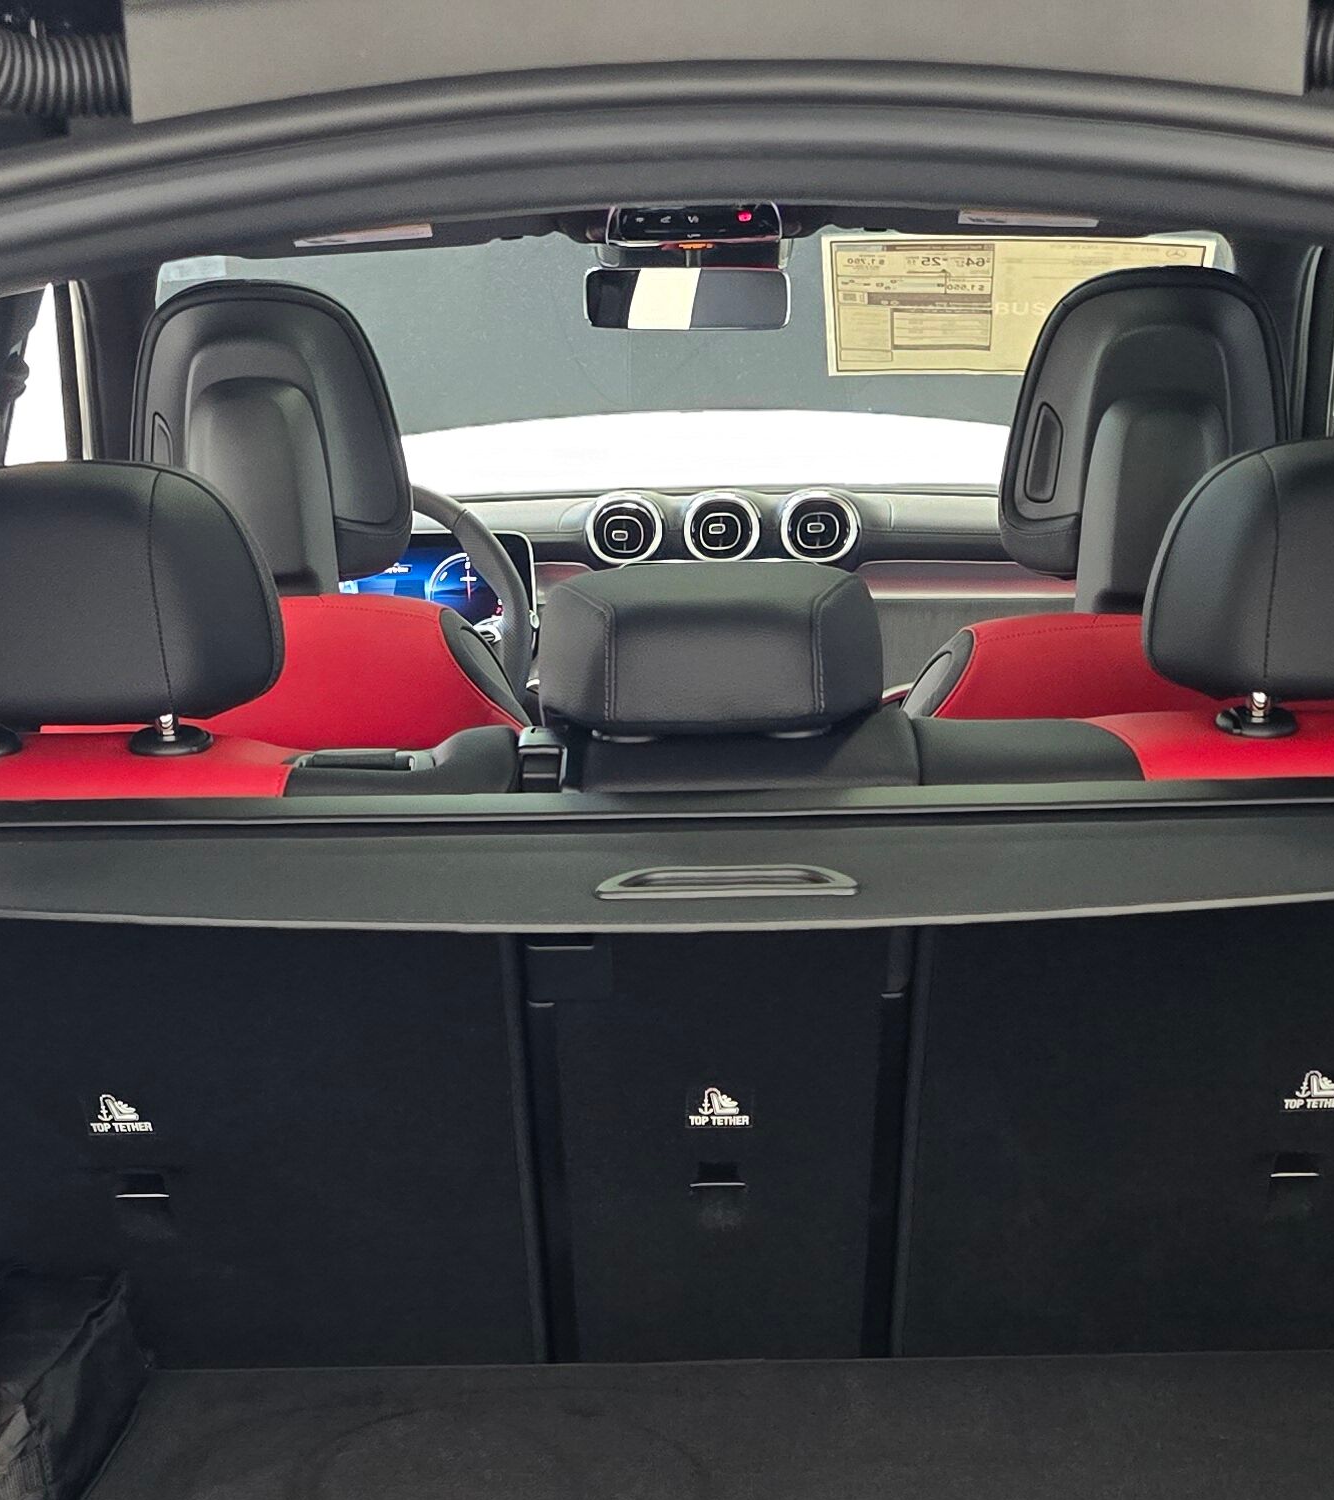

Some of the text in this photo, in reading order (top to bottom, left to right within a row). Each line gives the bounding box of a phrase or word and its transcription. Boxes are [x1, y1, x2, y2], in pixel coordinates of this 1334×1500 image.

[1283, 1098, 1305, 1110] TOP
[689, 1115, 750, 1126] TOP TETHER
[90, 1121, 153, 1133] TOP TETHER
